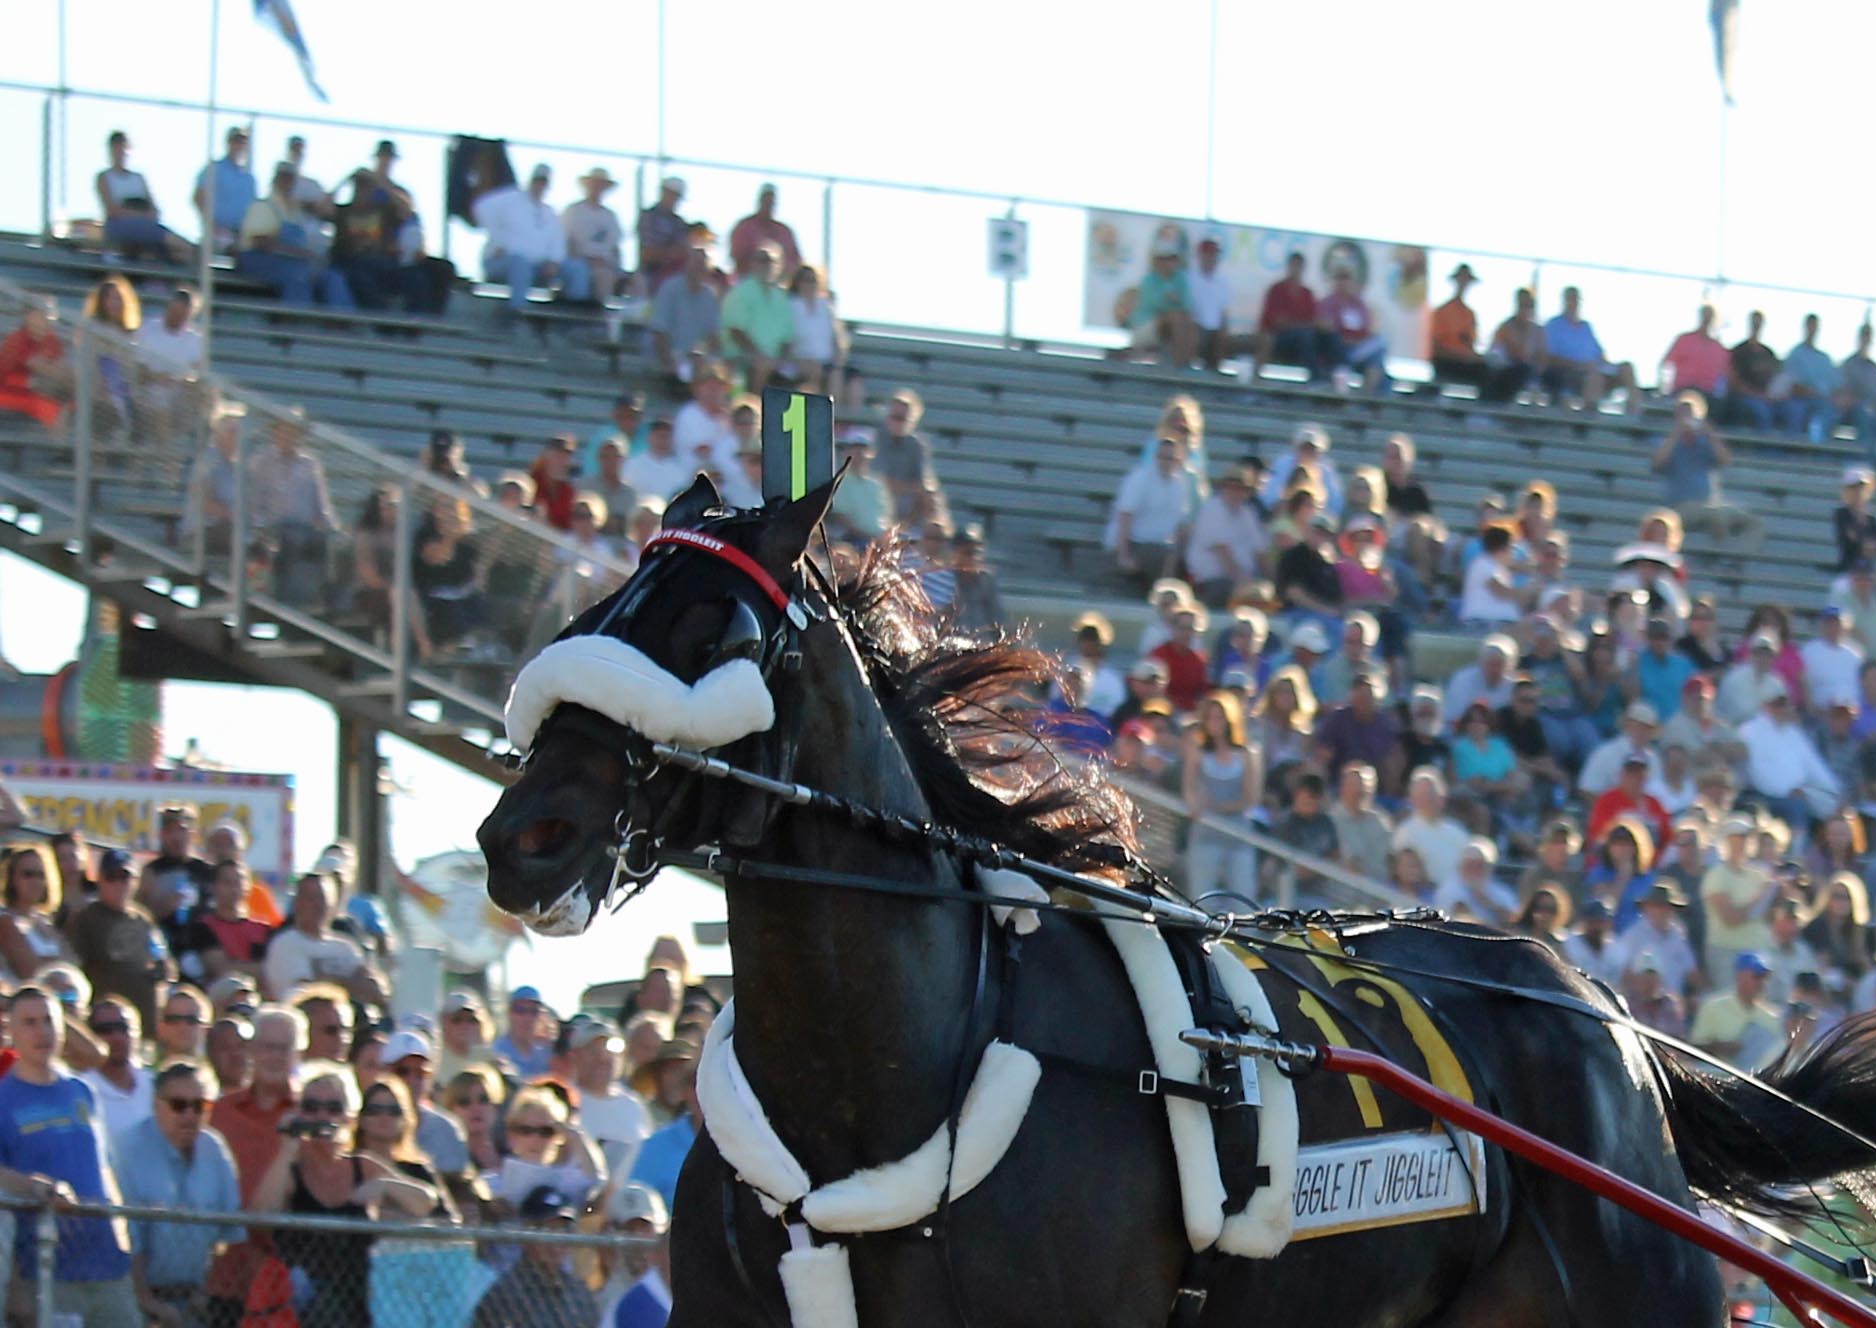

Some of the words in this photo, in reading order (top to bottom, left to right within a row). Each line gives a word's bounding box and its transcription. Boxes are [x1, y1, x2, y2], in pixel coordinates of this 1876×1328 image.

[782, 393, 806, 503] 1
[1293, 1162, 1345, 1217] GGLE
[1347, 1158, 1373, 1209] IT
[1374, 1146, 1459, 1206] JIGGLEIT
